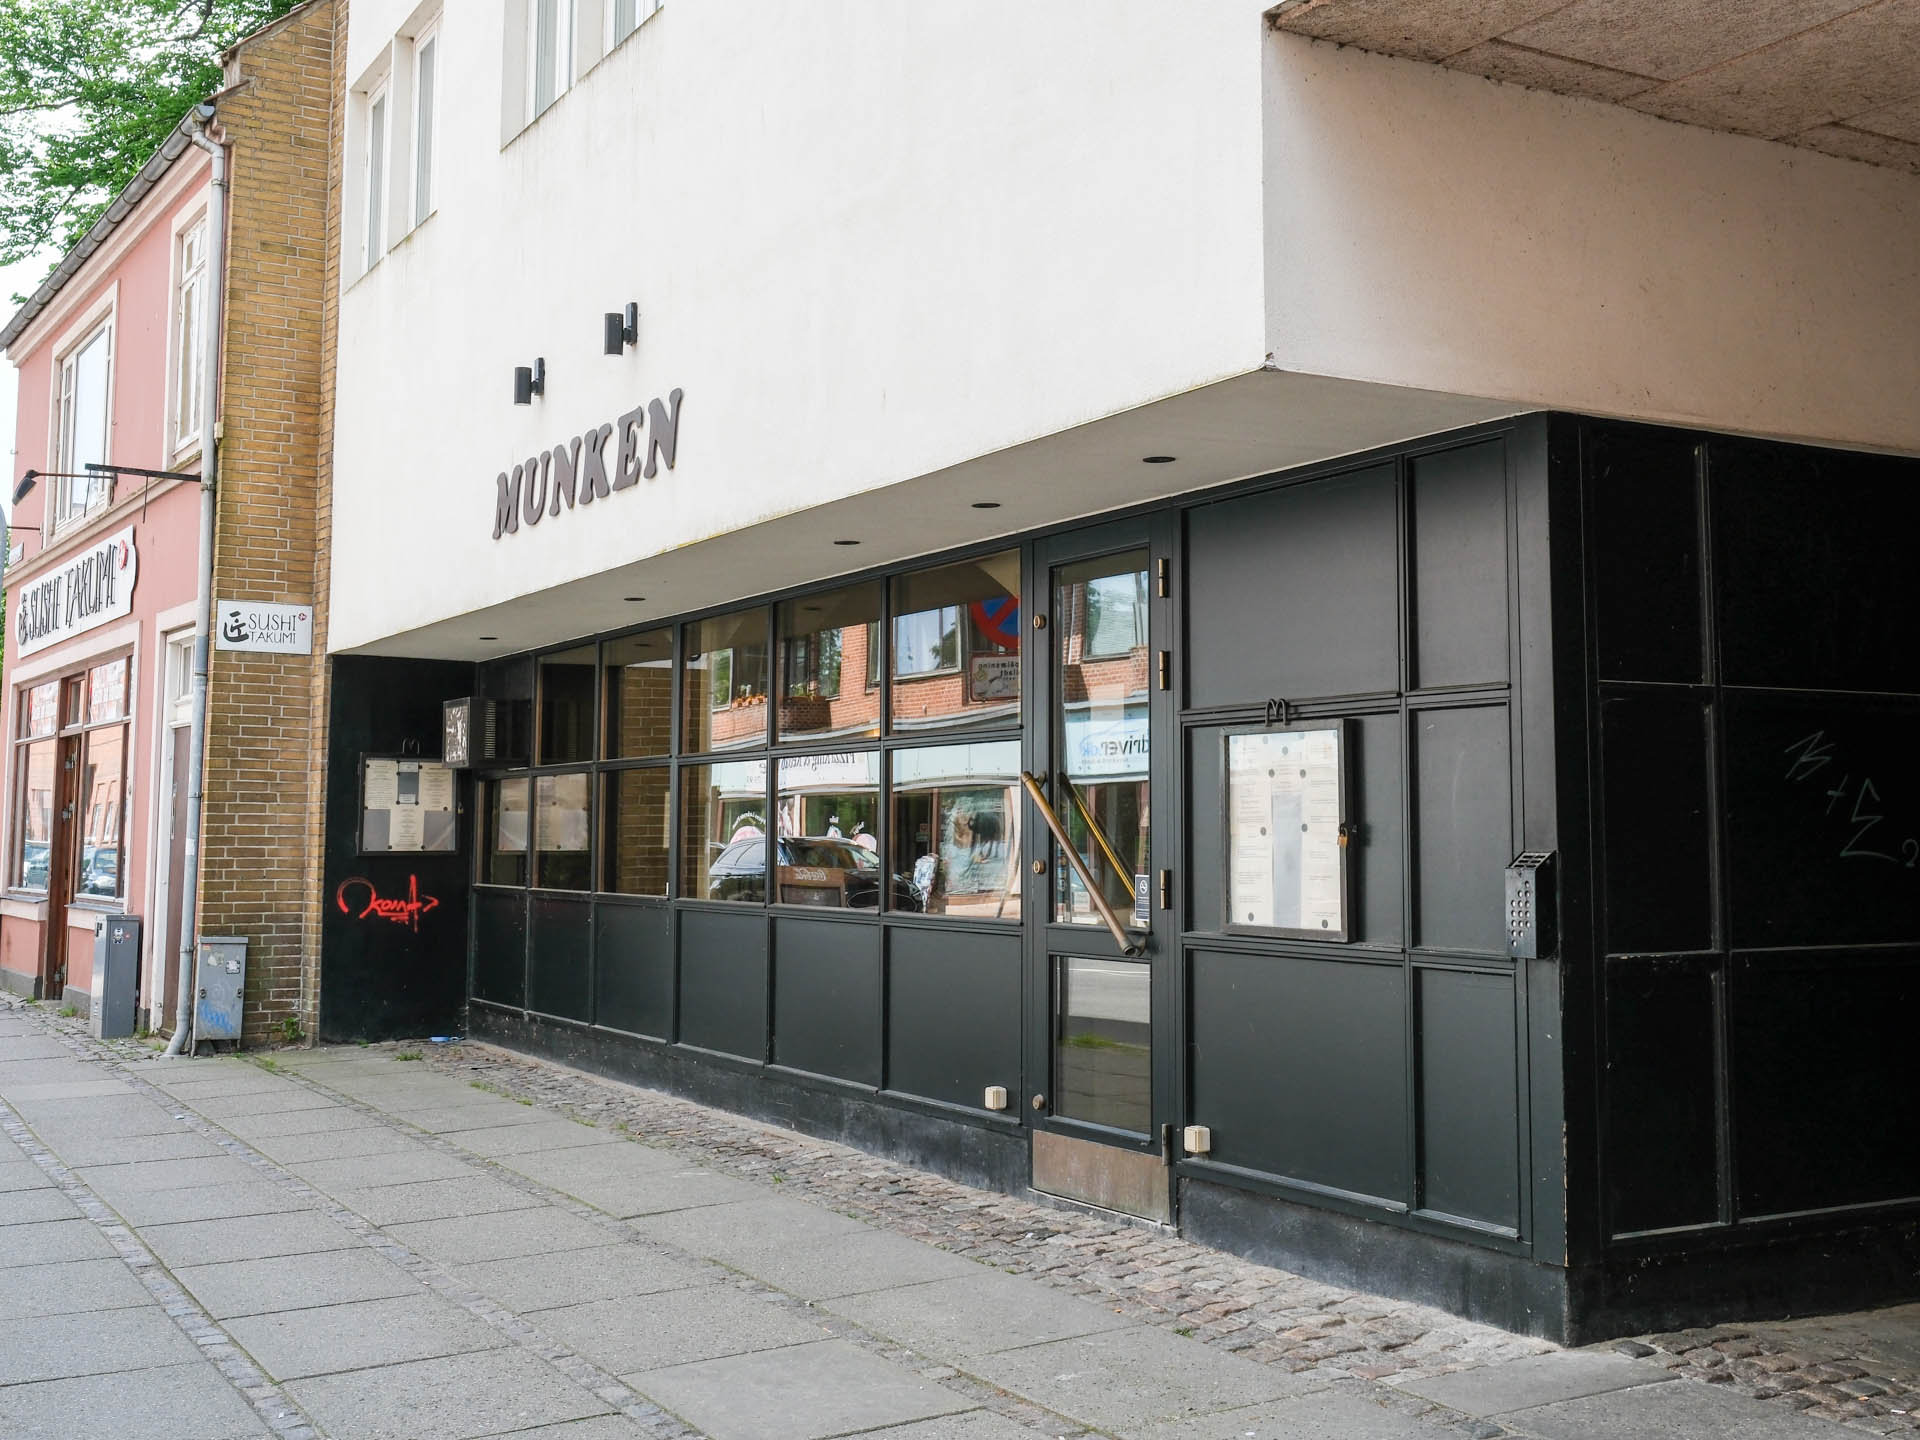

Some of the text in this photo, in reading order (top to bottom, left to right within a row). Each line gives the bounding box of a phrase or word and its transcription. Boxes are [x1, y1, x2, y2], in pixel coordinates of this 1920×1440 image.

[492, 387, 684, 541] MUNKEN
[29, 543, 118, 641] SUSHI TAKUMI
[248, 613, 297, 632] SUSHI
[248, 630, 297, 645] TAKUMI
